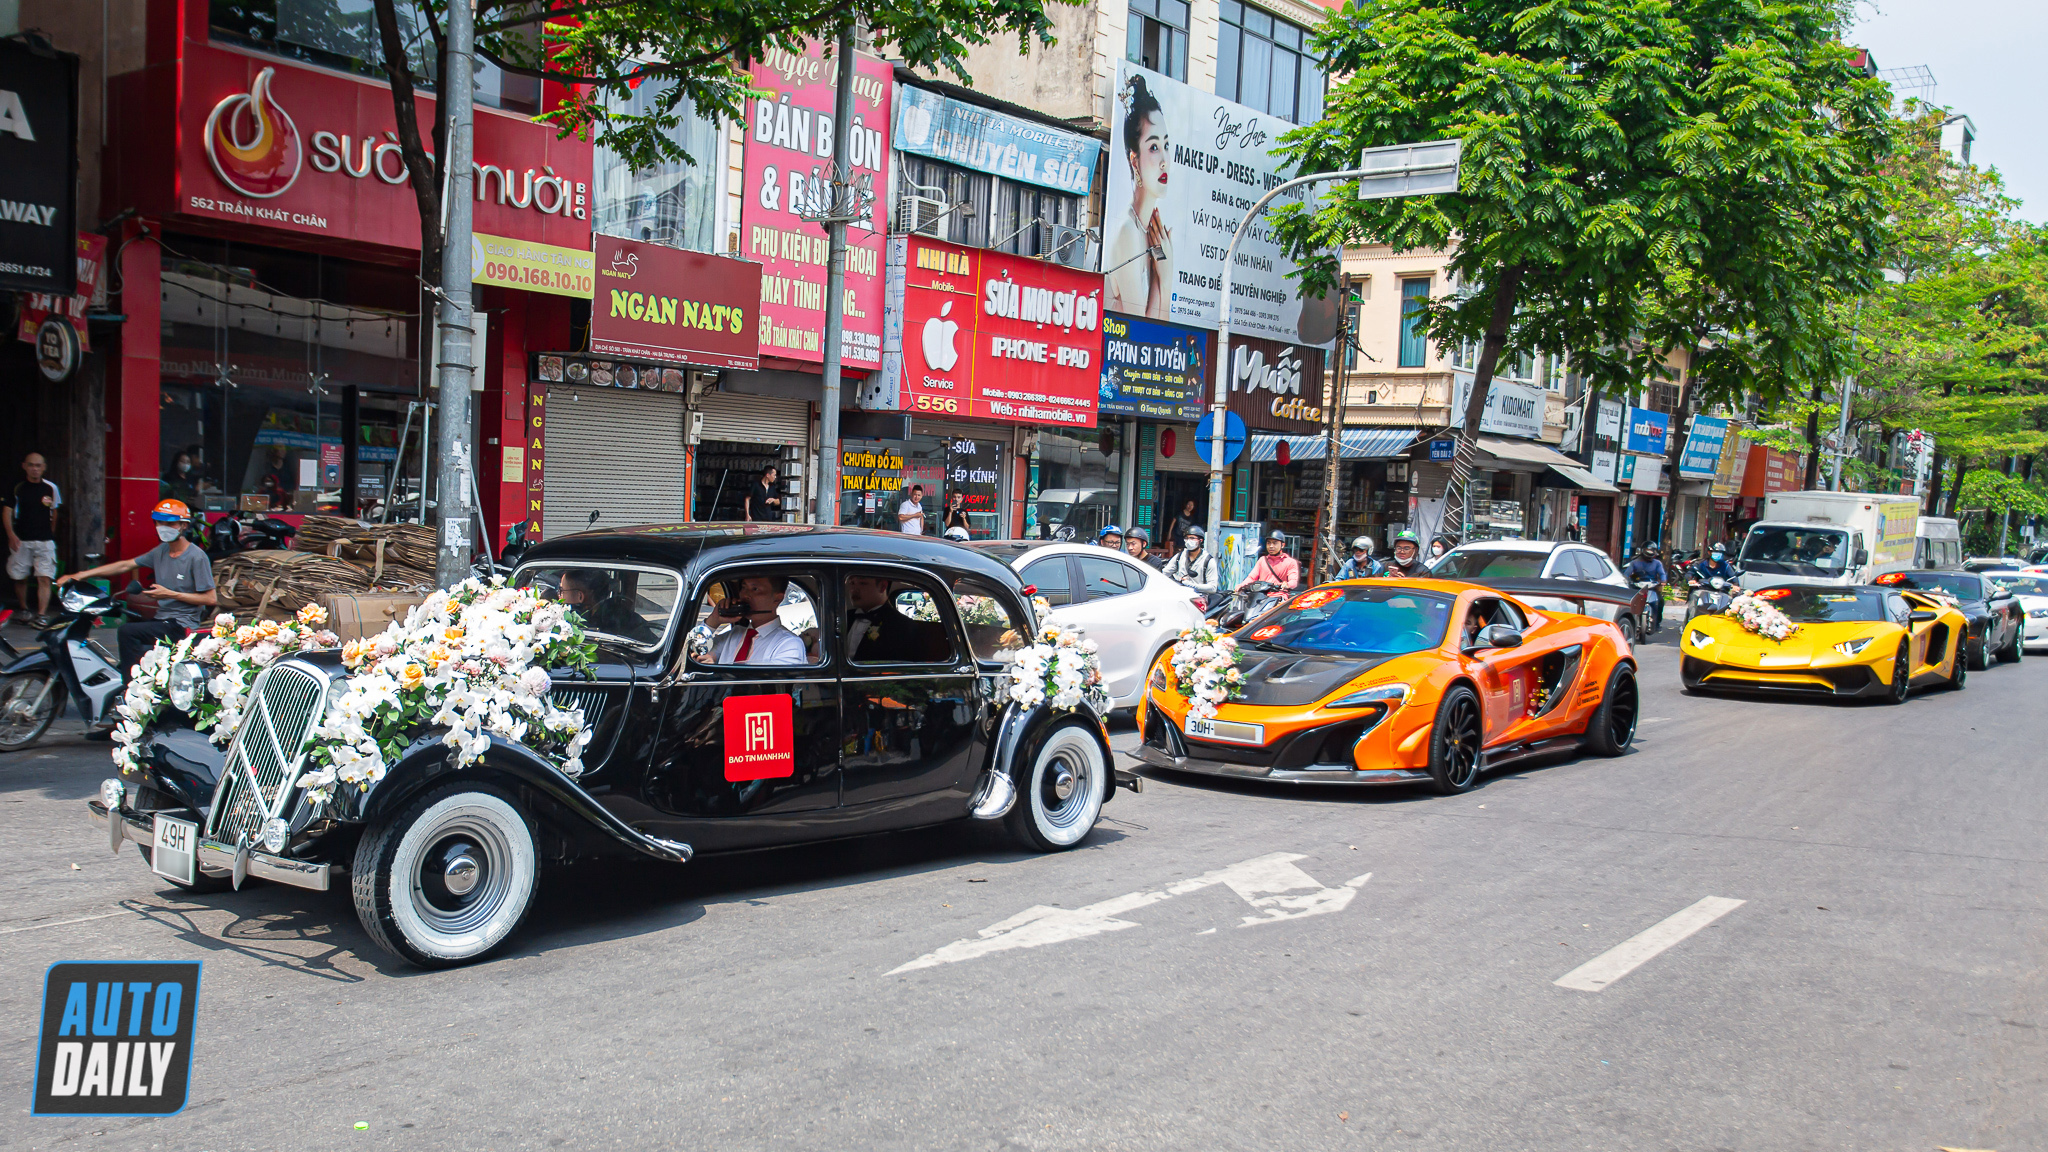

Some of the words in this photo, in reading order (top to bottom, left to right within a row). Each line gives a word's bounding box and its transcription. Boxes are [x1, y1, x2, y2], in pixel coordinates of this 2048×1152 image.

[756, 95, 811, 153] BÁN
[817, 113, 882, 172] BÔN
[933, 128, 1037, 181] CHUYÊN
[1041, 152, 1090, 192] SỬA
[1174, 144, 1203, 171] MAKE
[1206, 154, 1219, 174] UP
[1227, 161, 1255, 186] DRESS
[574, 182, 586, 220] BBQ
[760, 166, 781, 211] &
[1212, 189, 1228, 204] BÁN
[1229, 197, 1234, 206] &
[1236, 198, 1250, 211] CHO
[0, 199, 56, 226] WAY
[190, 196, 215, 211] 562
[217, 200, 253, 216] TRẦN
[256, 207, 290, 222] KHÁT
[292, 213, 327, 228] CHÂN
[1192, 208, 1210, 227] VÁY
[1212, 216, 1223, 233] DẠ
[1247, 223, 1263, 241] VÁY
[486, 243, 514, 258] GIAO
[517, 244, 548, 264] HÀNG
[551, 252, 573, 268] TẬN
[574, 255, 593, 270] NƠI
[752, 226, 778, 264] PHỤ
[781, 228, 810, 268] KIỆN
[844, 245, 877, 281] THOẠI
[917, 247, 946, 276] NHỊ
[946, 250, 970, 276] HÀ
[1200, 243, 1218, 260] VEST
[1251, 256, 1273, 273] NHÂN
[486, 262, 592, 293] 090.168.10.10
[602, 269, 616, 277] NGAN
[932, 280, 954, 292] Mobile
[762, 271, 790, 306] MÁY
[793, 275, 821, 311] TÍNH
[984, 269, 1019, 320] SỬA
[1021, 286, 1053, 329] MỌI
[1052, 290, 1077, 334] SỰ
[1076, 288, 1100, 332] CỐ
[1179, 271, 1206, 288] TRANG
[1209, 273, 1222, 291] ĐIỂ
[1231, 283, 1259, 299] CHUYÊN
[1260, 289, 1287, 307] NGHIỆP
[610, 288, 678, 326] NGAN
[682, 300, 744, 334] NAT'S
[773, 321, 788, 348] TRẦN
[788, 326, 803, 350] KHÁT
[804, 328, 819, 352] CHÂN
[1103, 317, 1127, 337] Shop
[992, 336, 1048, 363] IPHONE
[1057, 346, 1090, 369] IPAD
[1108, 340, 1138, 366] PATIN
[1154, 337, 1186, 372] TUYỂN
[923, 375, 954, 390] Service
[917, 396, 958, 413] 556
[1018, 406, 1087, 423] nhihamobile.vn
[1271, 397, 1321, 422] Coffee
[843, 451, 876, 469] CHUYÊN
[877, 449, 889, 470] ĐỒ
[890, 456, 904, 470] ZIN
[969, 466, 995, 483] KÍNH
[843, 475, 863, 490] THAY
[865, 470, 881, 490] LẤY
[881, 477, 903, 491] NGAY
[161, 822, 186, 851] 49H
